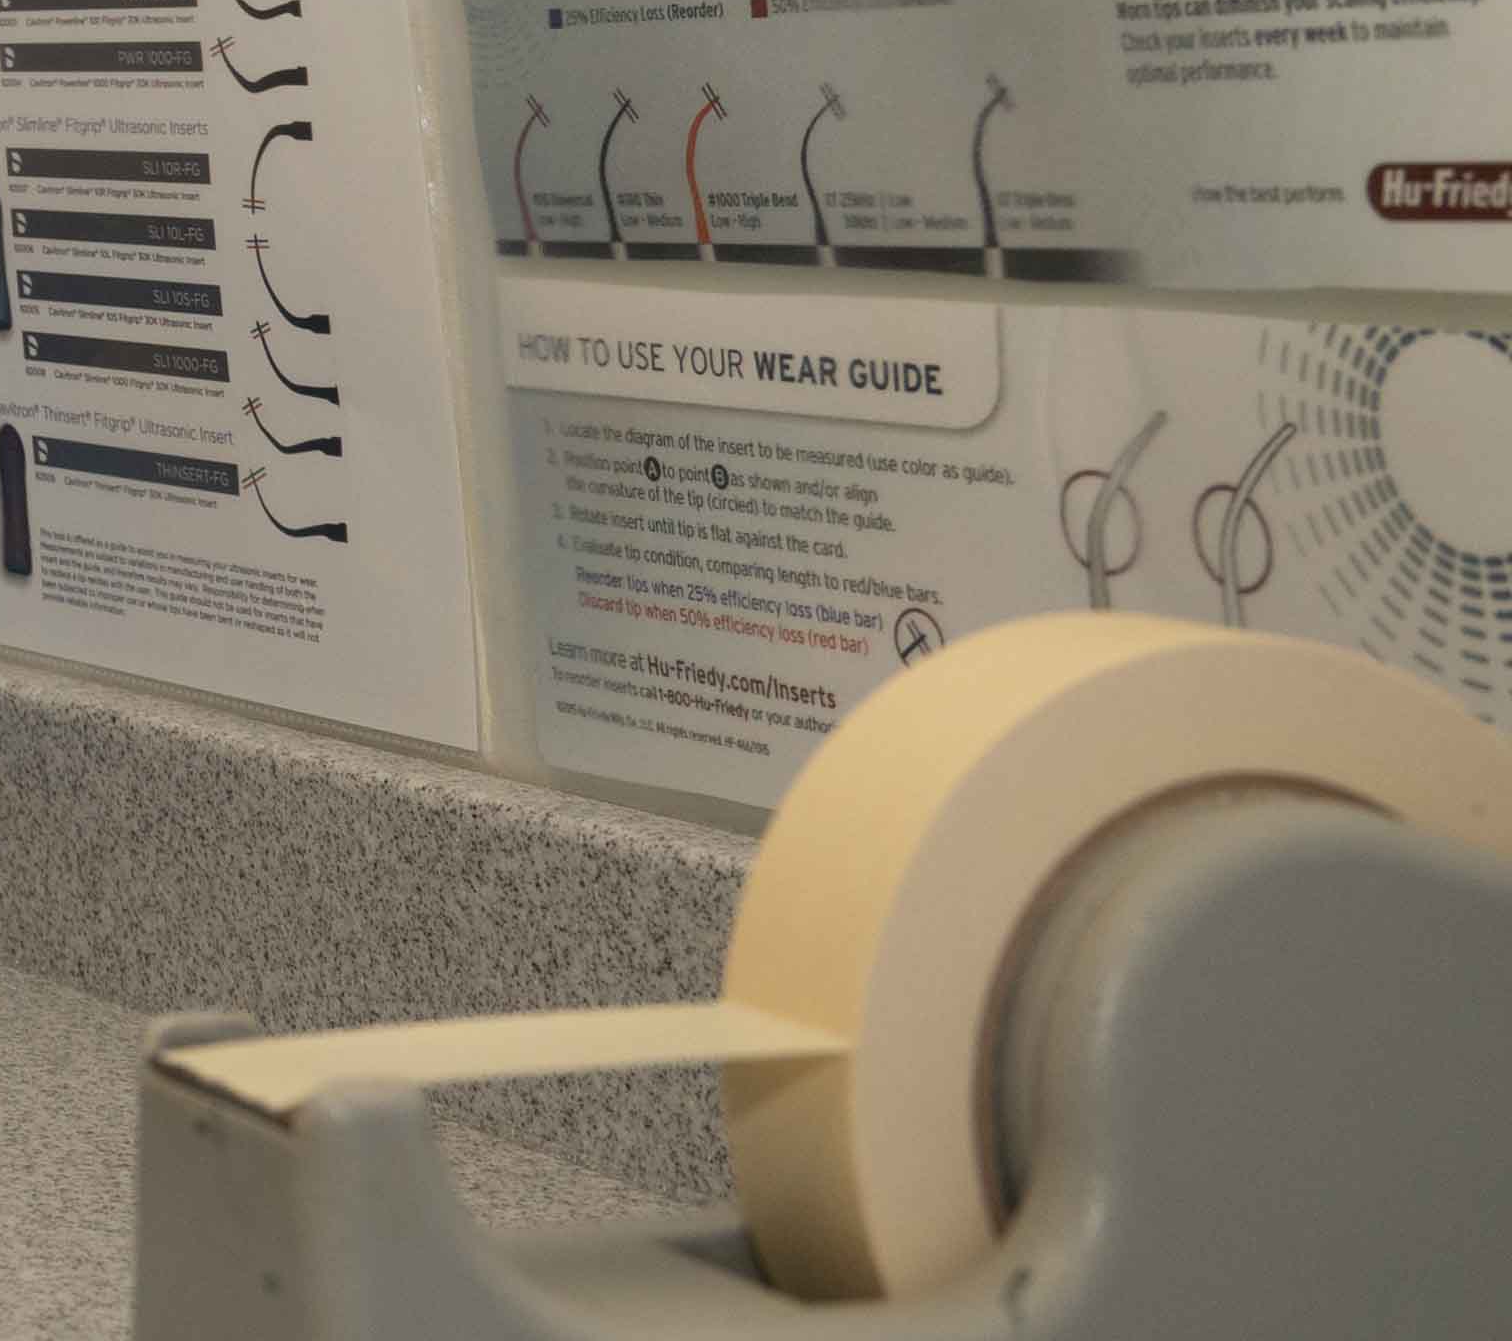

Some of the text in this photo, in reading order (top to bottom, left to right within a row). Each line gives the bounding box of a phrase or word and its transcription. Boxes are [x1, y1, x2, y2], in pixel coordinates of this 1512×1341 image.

[170, 118, 208, 136] Inserts
[1381, 168, 1512, 216] Hu-Fried
[519, 334, 943, 395] HOW TO USE YOUR WEAR GUIDE
[199, 427, 234, 445] Insert
[627, 574, 649, 597] tips
[652, 581, 683, 597] when
[721, 590, 782, 618] efficiency
[785, 601, 812, 619] loss
[816, 605, 850, 626] (blue
[854, 609, 883, 632] bar)
[647, 655, 836, 709] Hu-Friedy.com/Inserts
